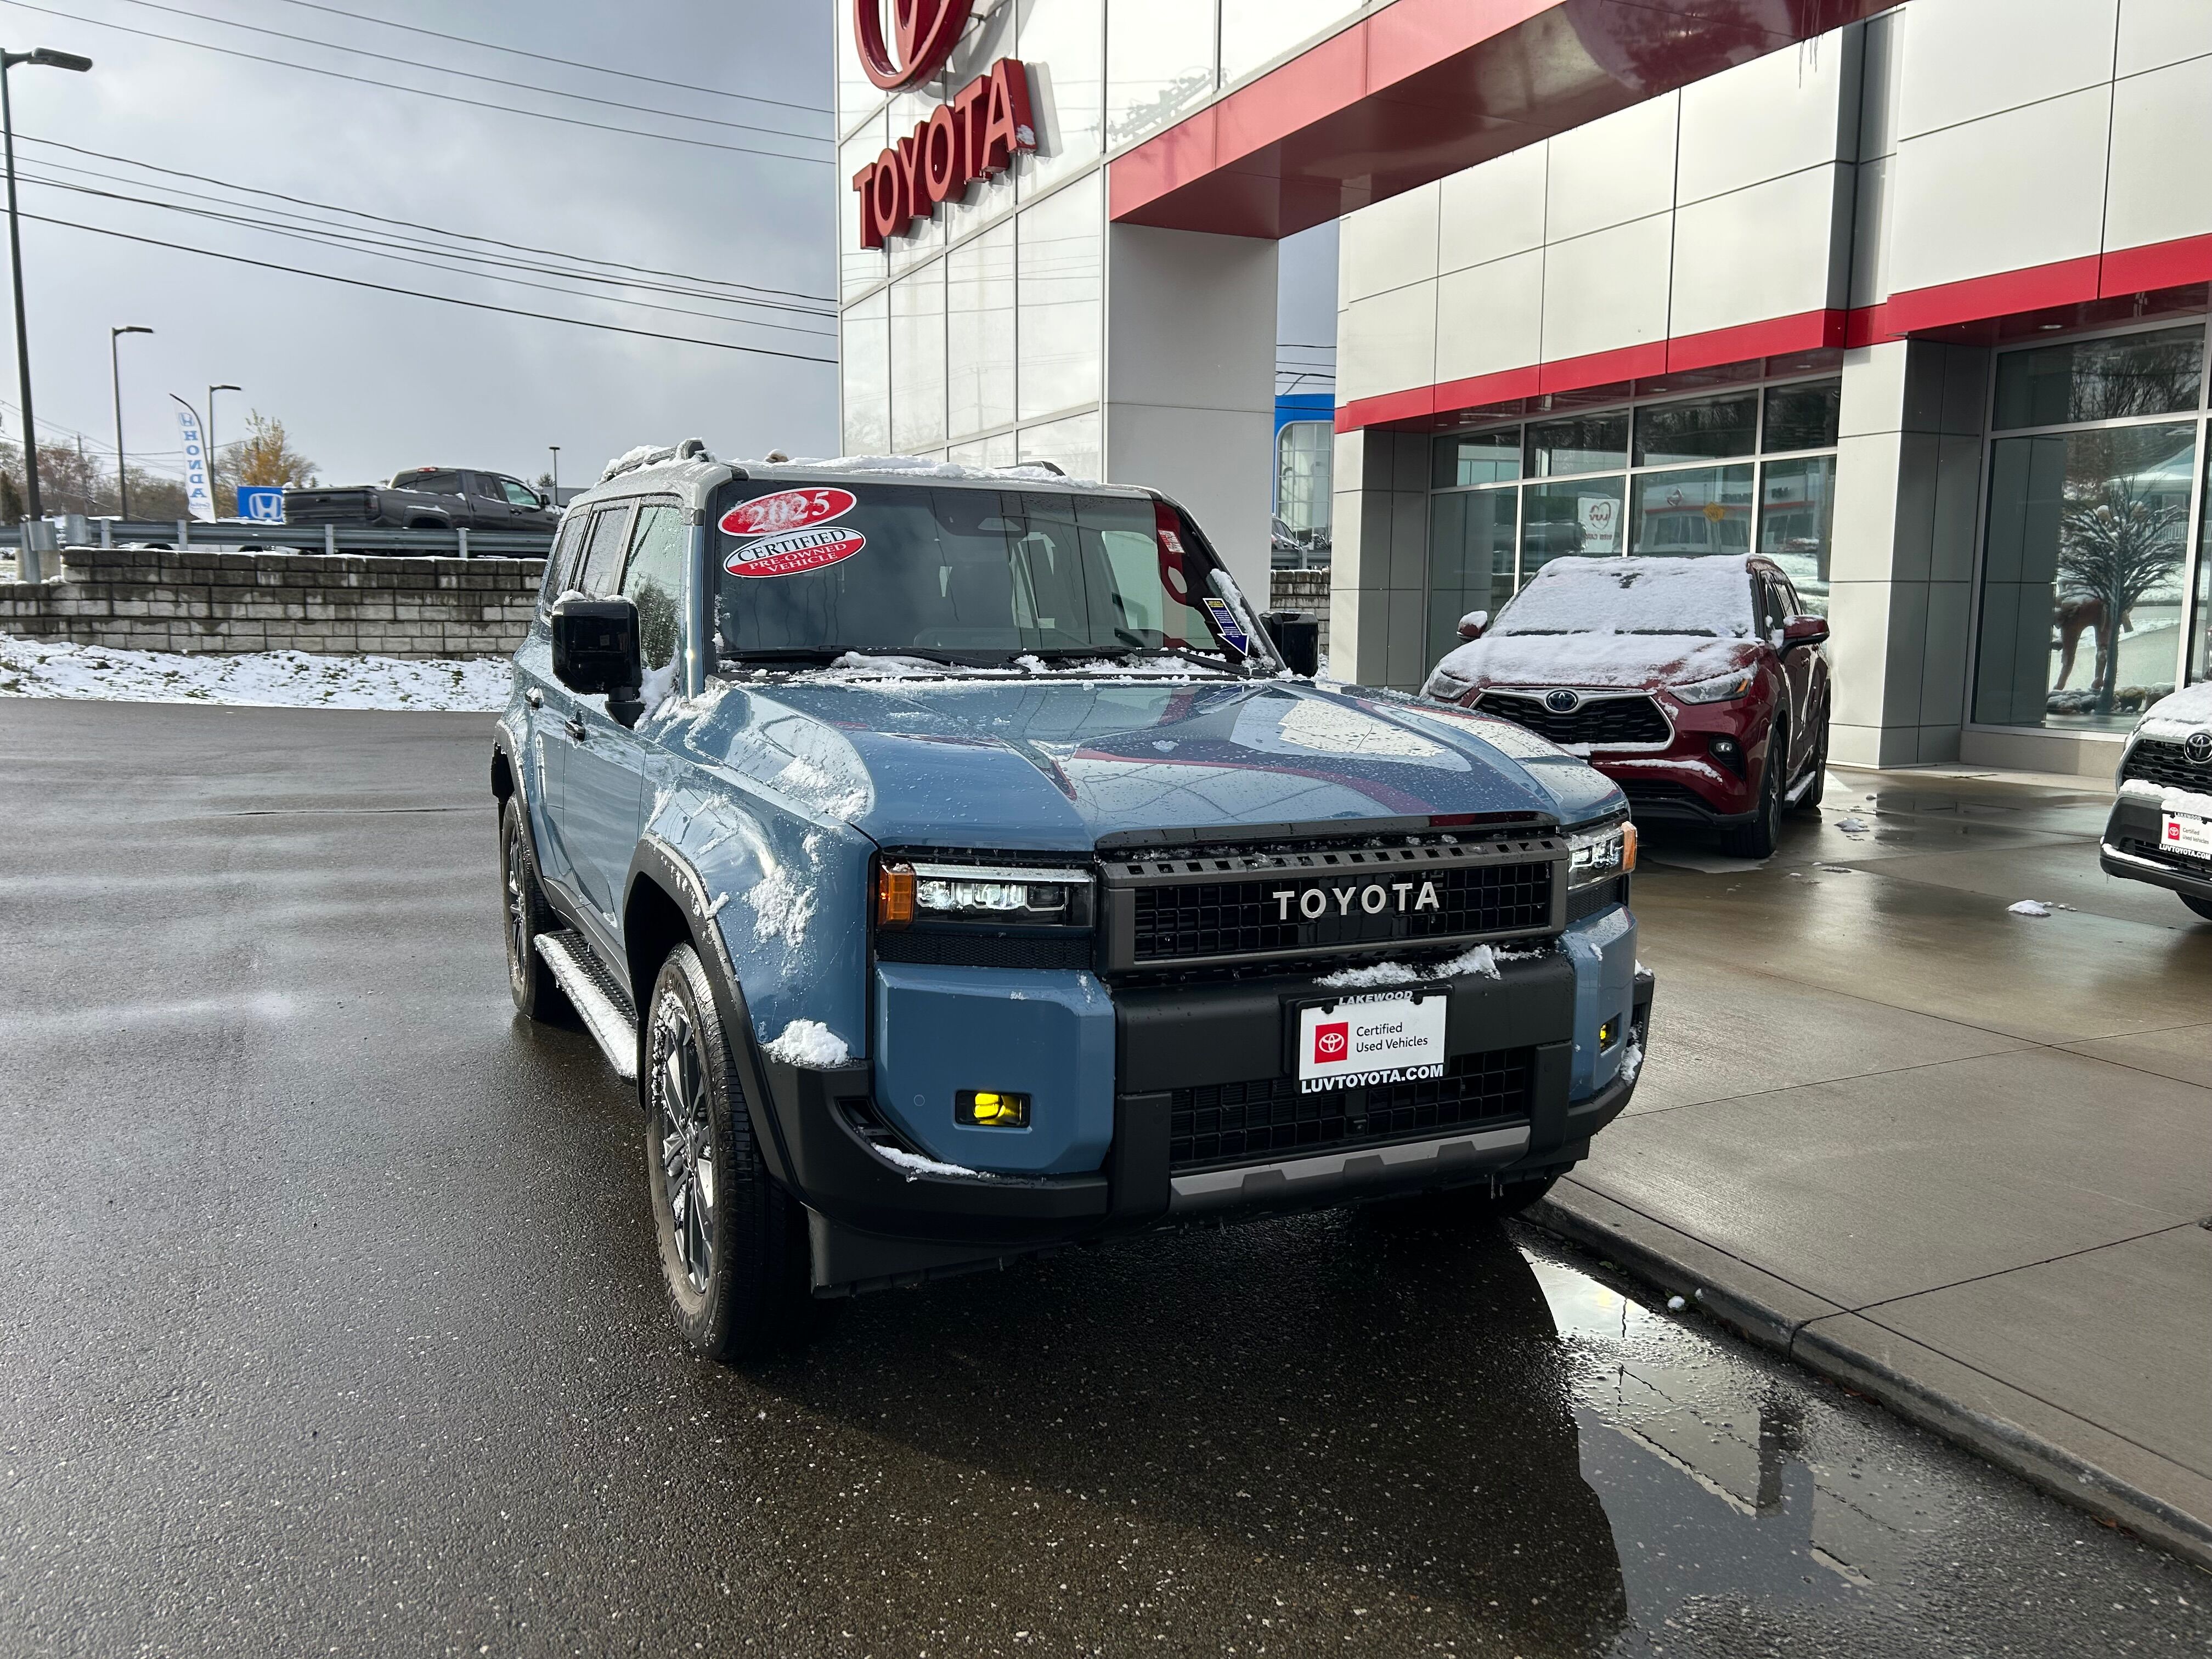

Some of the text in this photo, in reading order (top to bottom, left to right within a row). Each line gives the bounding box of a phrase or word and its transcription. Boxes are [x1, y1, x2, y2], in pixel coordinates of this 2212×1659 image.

[853, 57, 1036, 251] TOYOTA
[748, 491, 829, 532] 2025
[737, 530, 847, 562] CERTIFIED
[749, 543, 847, 570] PRE-OWNED
[766, 552, 838, 573] VEHICLE
[2182, 827, 2200, 836] Certified
[2159, 843, 2211, 860] LUVTOYOTA.COM
[1273, 882, 1440, 920] TOYOTA
[1339, 990, 1413, 1006] LAKEWOOD
[1356, 1022, 1402, 1037] Certified
[1356, 1036, 1428, 1053] Used Vehicles
[1301, 1064, 1443, 1094] LUVTOYOTA.COM
